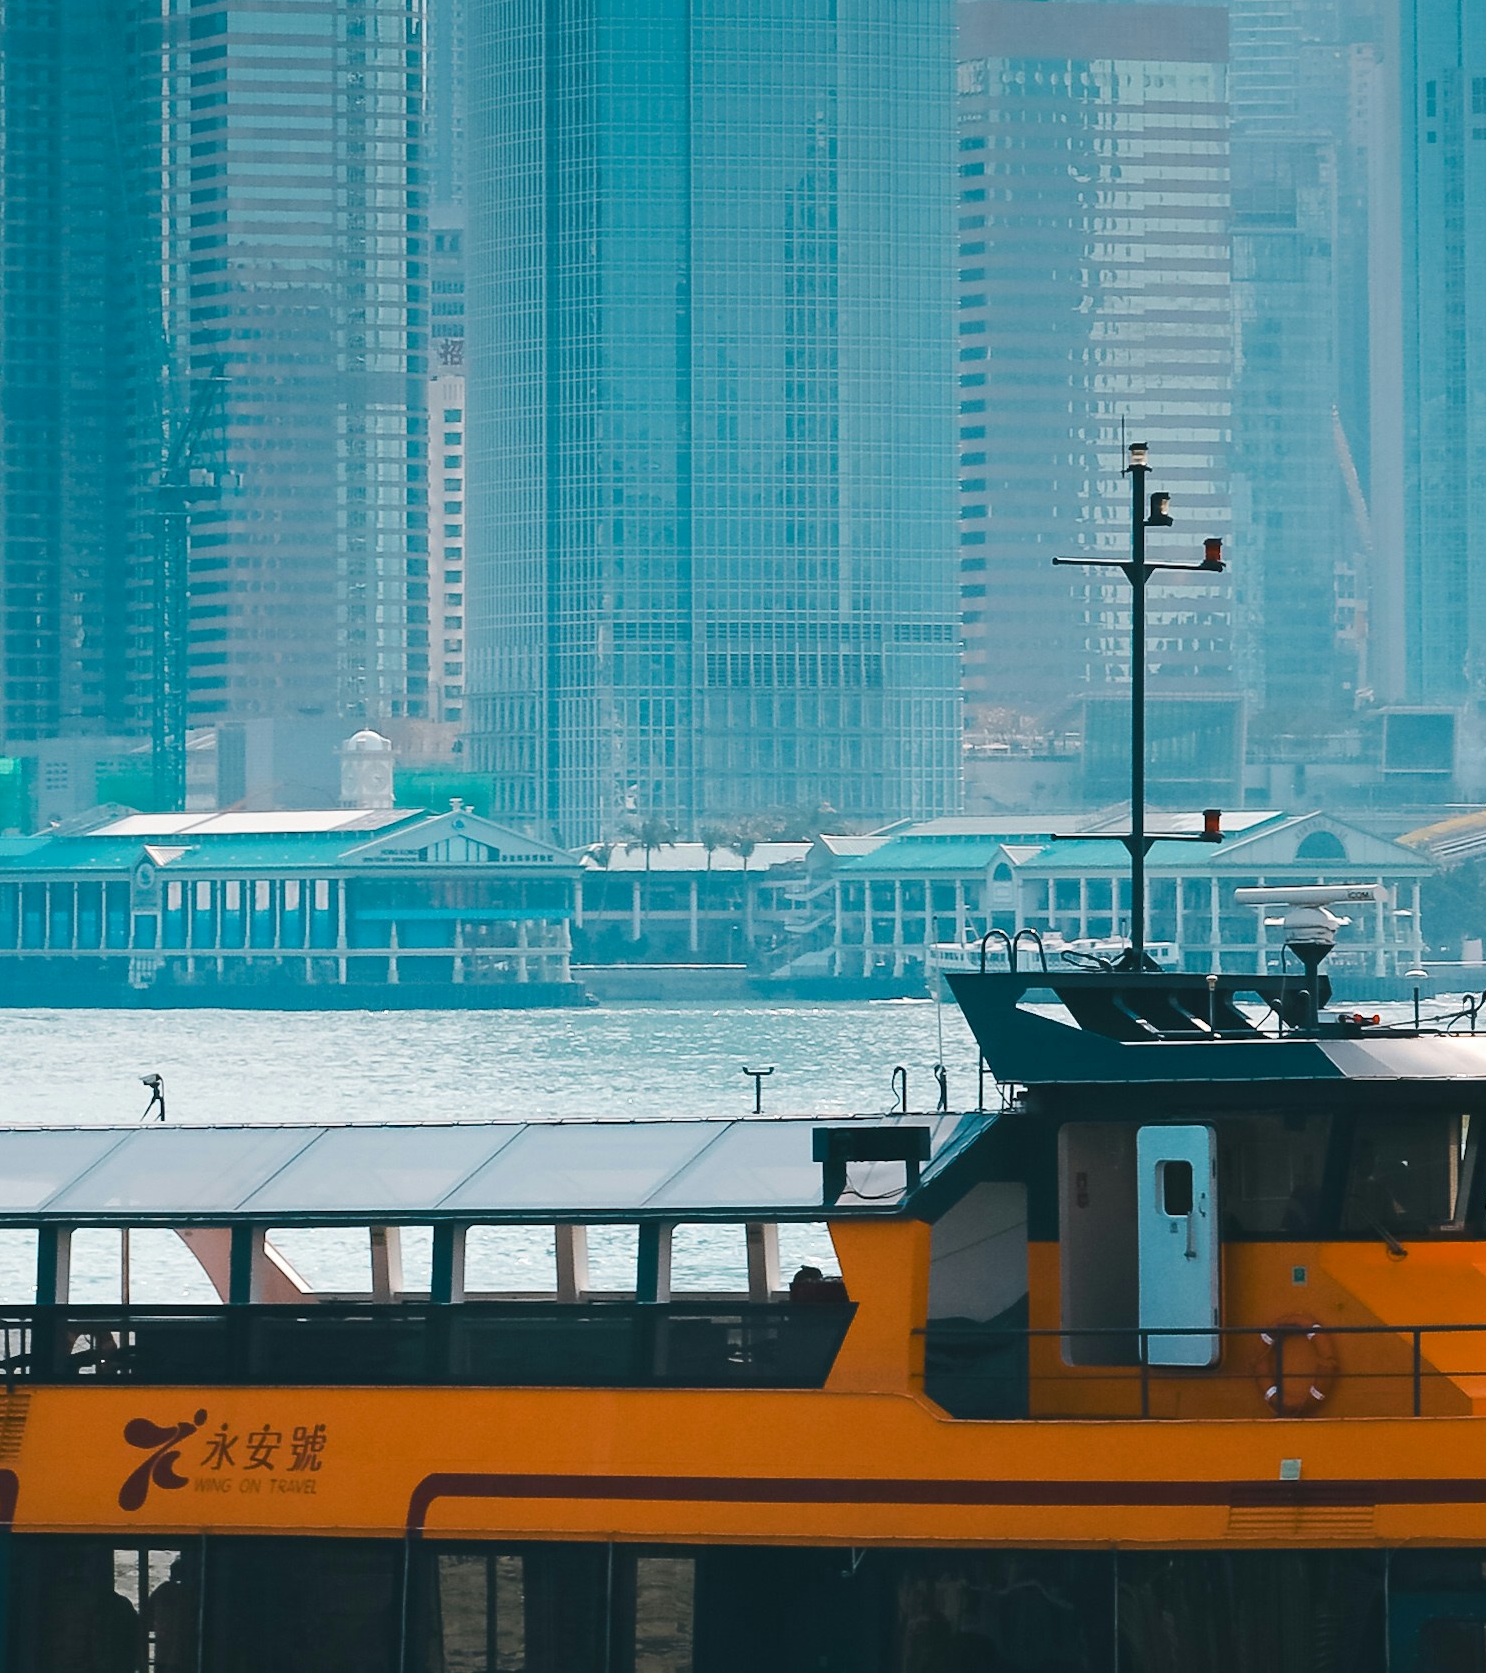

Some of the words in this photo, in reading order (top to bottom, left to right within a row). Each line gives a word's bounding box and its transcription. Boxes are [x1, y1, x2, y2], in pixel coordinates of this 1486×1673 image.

[200, 1422, 327, 1472] 永安號
[194, 1477, 233, 1494] WING
[239, 1477, 261, 1494] ON
[269, 1478, 317, 1495] TRAVEL
